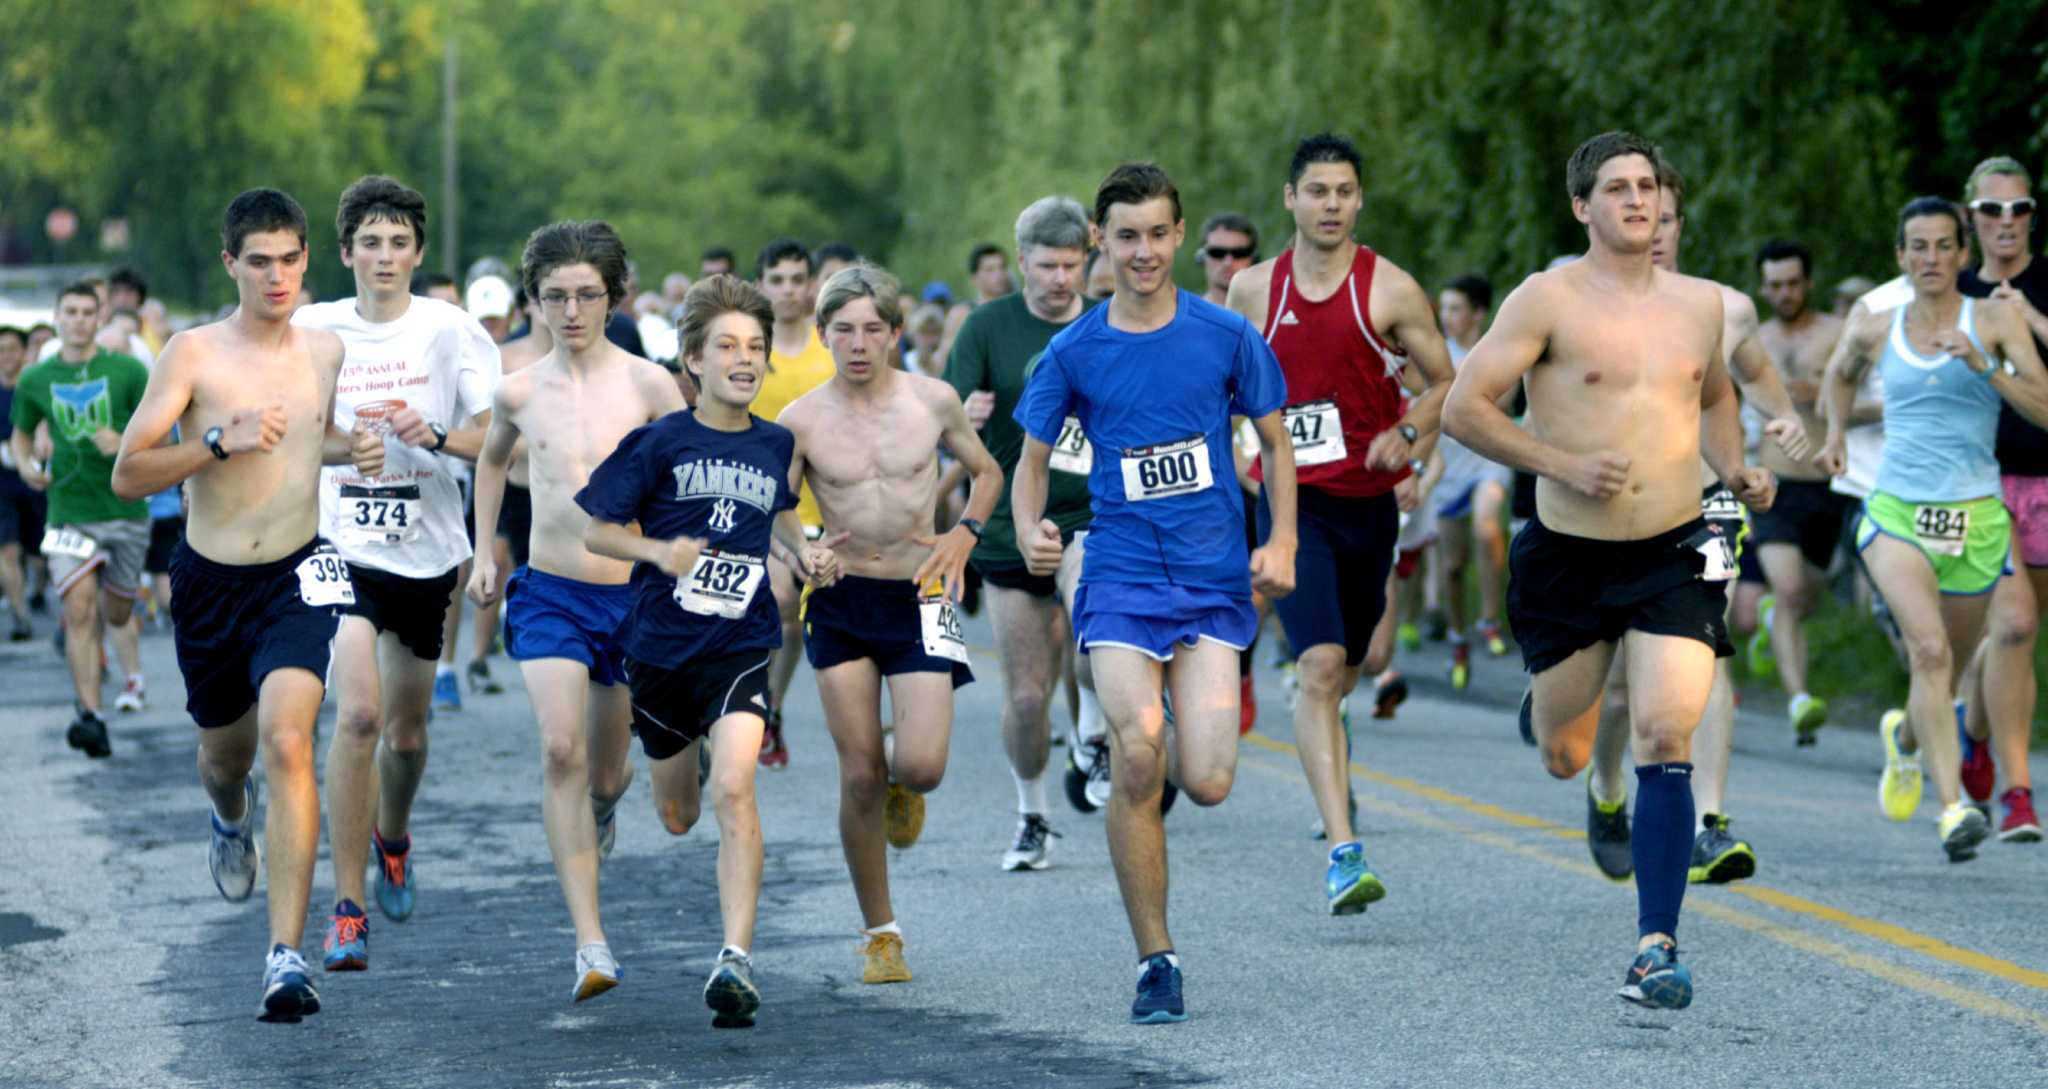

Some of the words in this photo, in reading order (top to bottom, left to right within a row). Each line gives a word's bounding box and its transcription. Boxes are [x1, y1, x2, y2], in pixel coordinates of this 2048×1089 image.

[365, 381, 394, 391] Hoop
[398, 375, 430, 387] Camp
[1139, 451, 1197, 488] 600
[672, 462, 777, 511] YANKEES
[355, 500, 407, 527] 374
[1916, 507, 1966, 535] 484
[693, 559, 750, 595] 432
